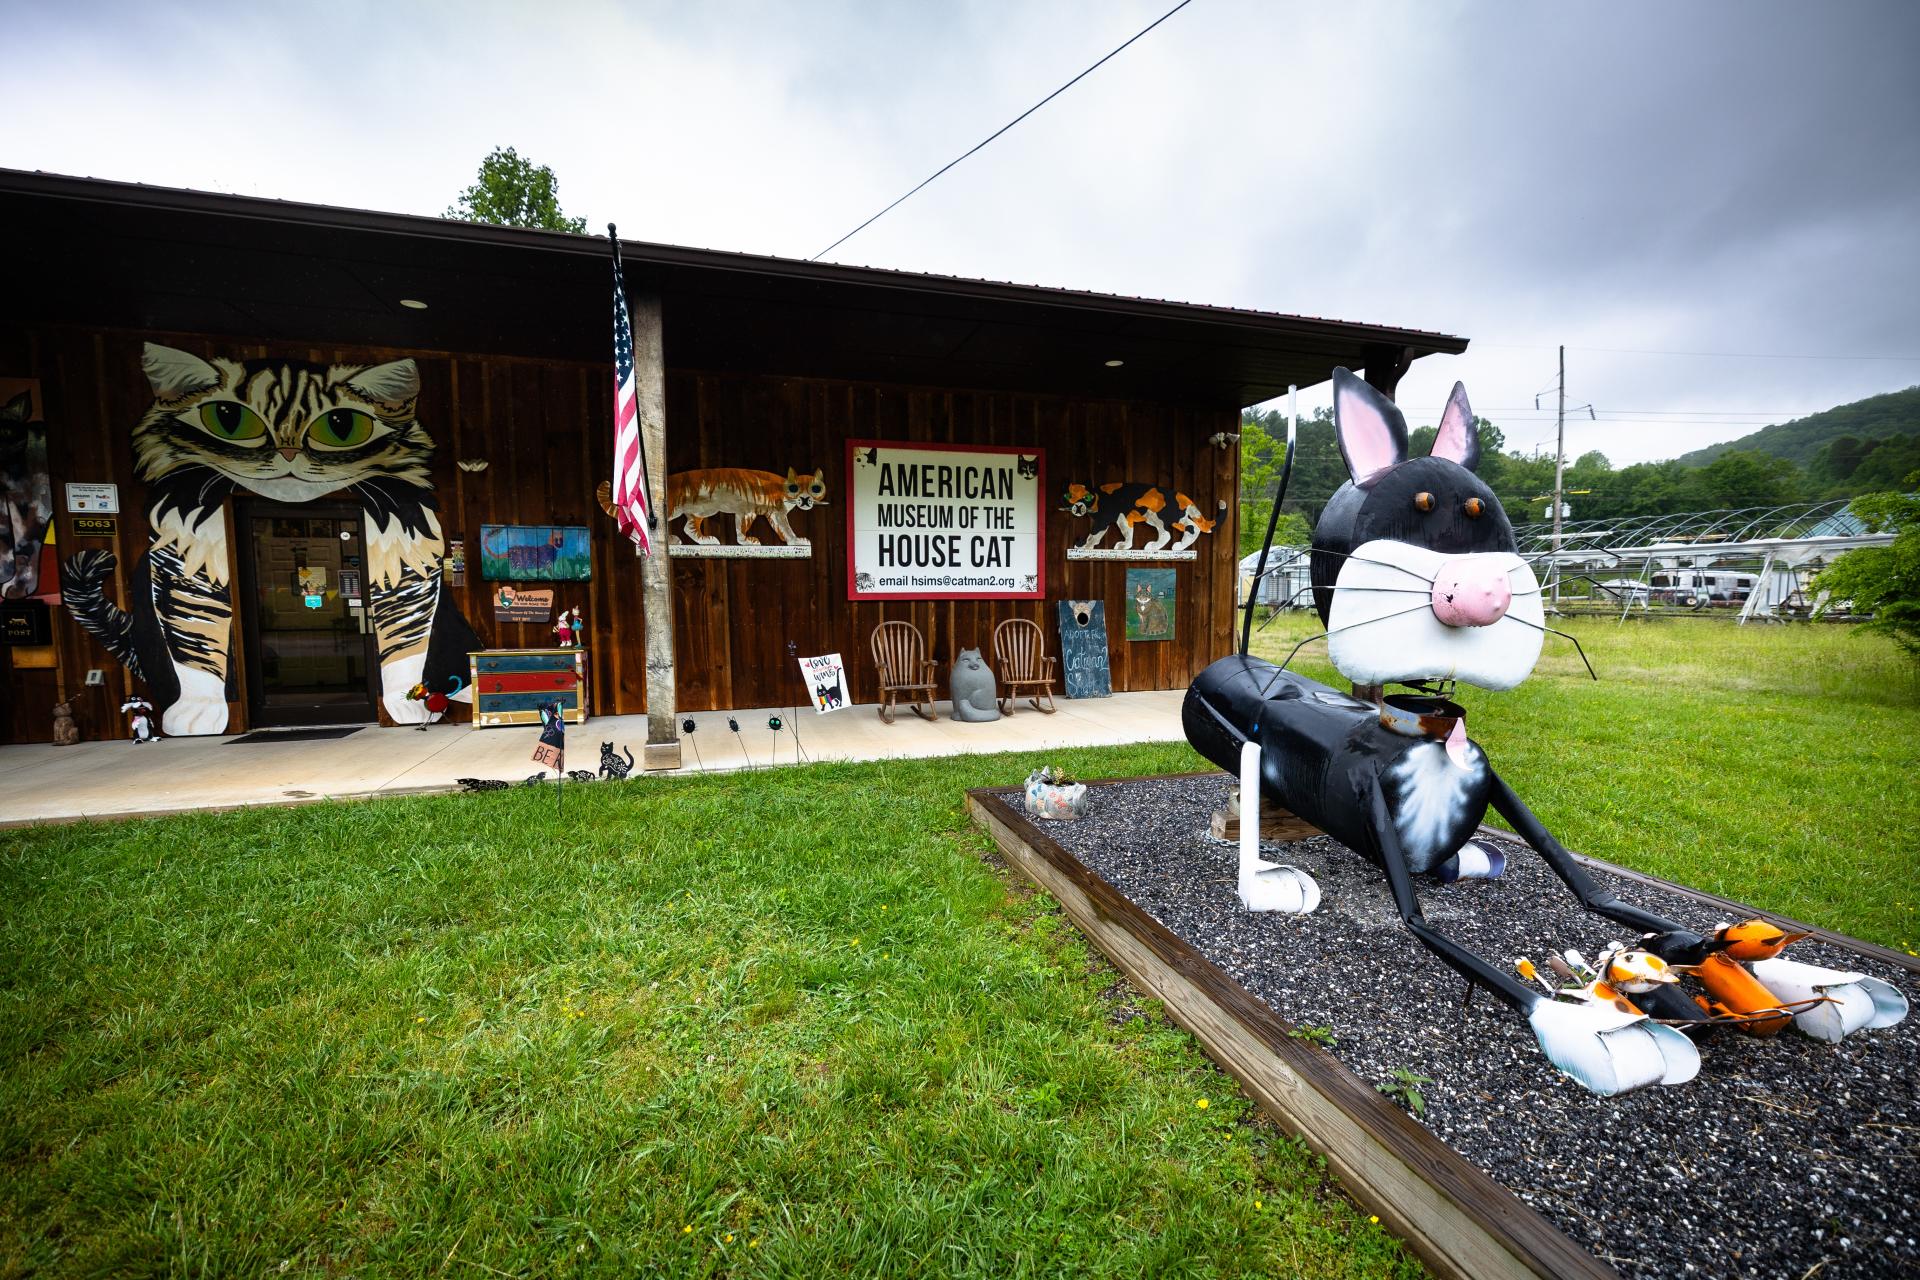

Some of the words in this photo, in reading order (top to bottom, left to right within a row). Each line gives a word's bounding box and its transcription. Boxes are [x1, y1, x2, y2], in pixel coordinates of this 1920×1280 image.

[878, 463, 1013, 500] AMERICAN
[79, 520, 111, 528] 5063
[878, 503, 953, 529] MUSEUM
[959, 506, 979, 529] OF
[983, 506, 1015, 530] THE
[878, 534, 961, 568] HOUSE
[971, 535, 1015, 568] CAT
[879, 575, 908, 586] email
[911, 575, 1015, 588] hsims@catman2.org
[517, 594, 548, 602] Welcome
